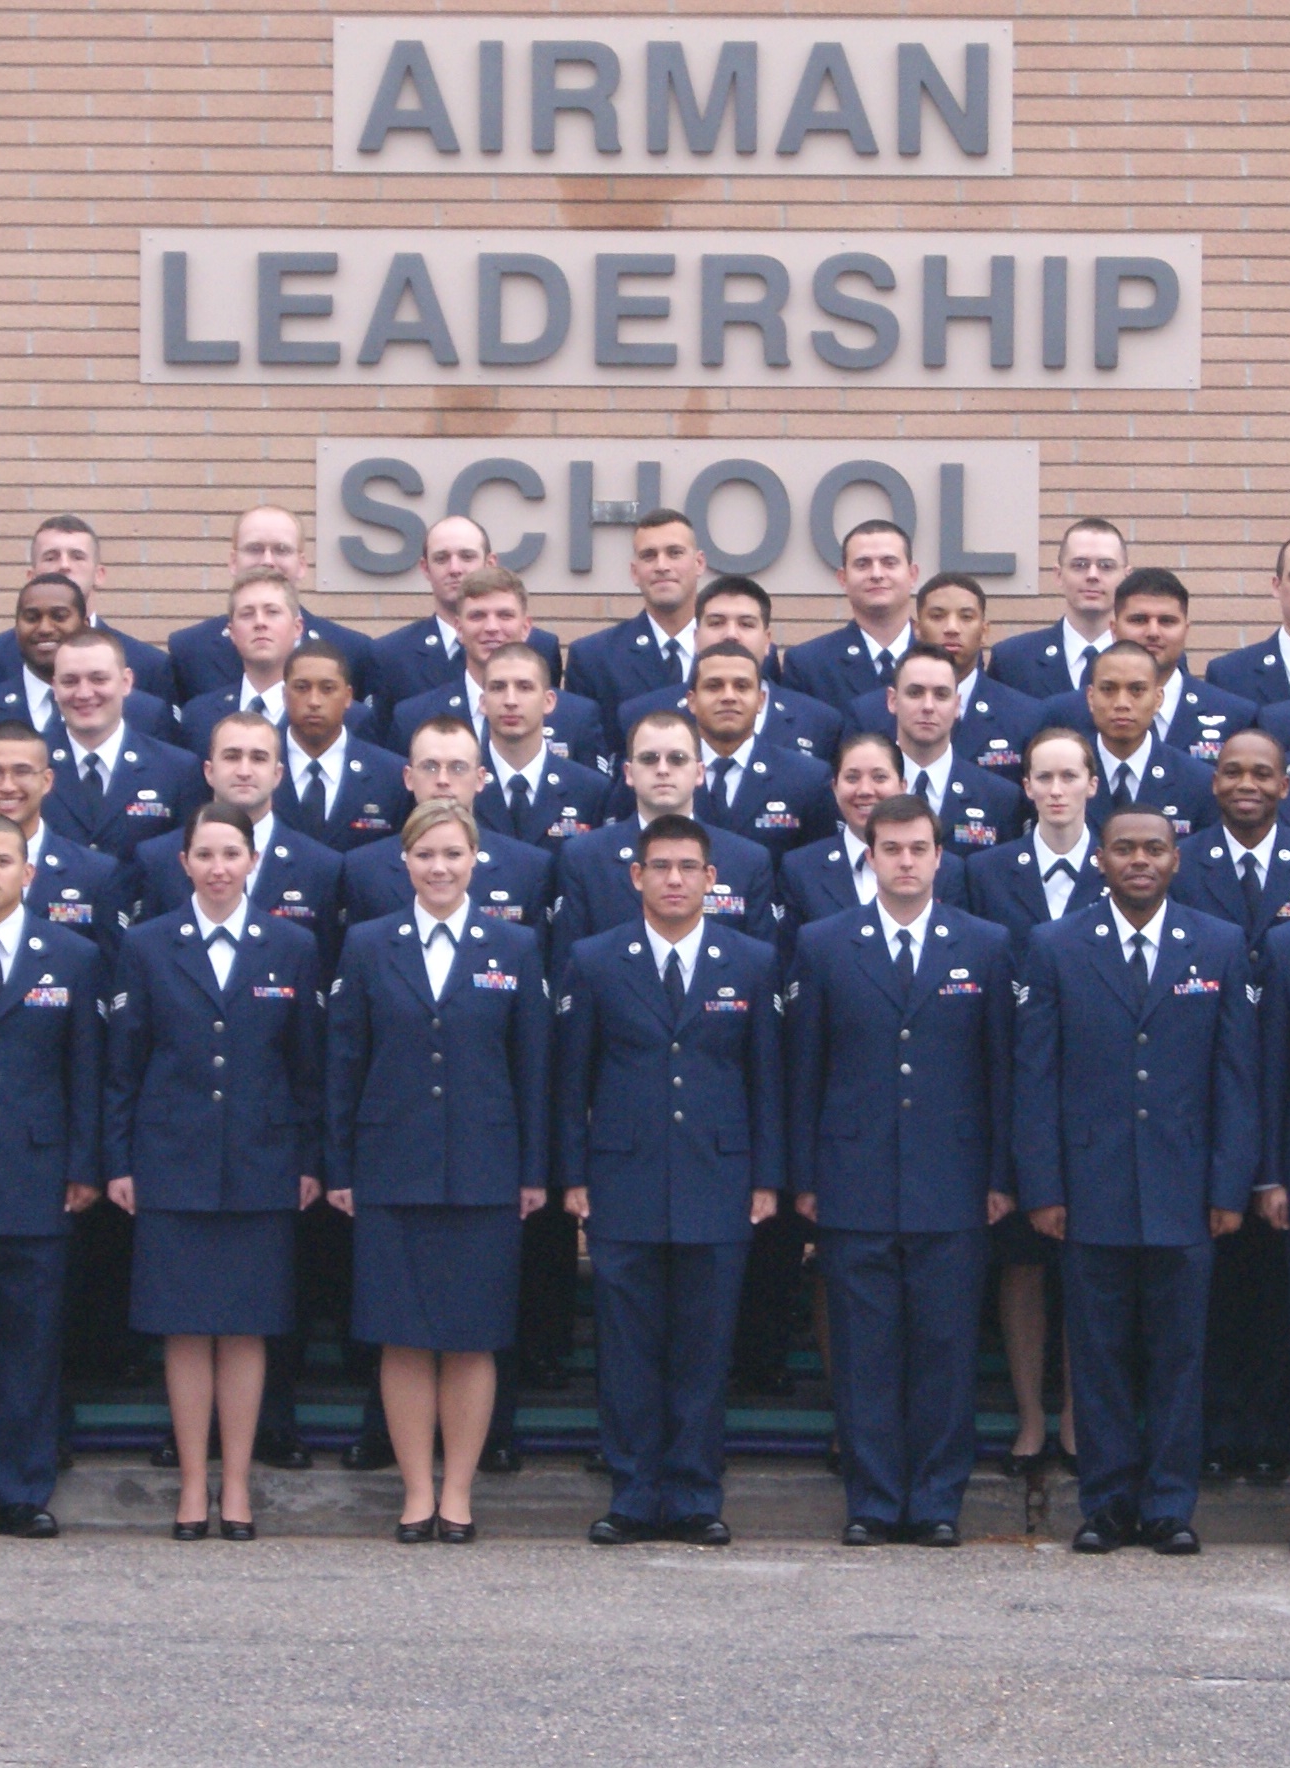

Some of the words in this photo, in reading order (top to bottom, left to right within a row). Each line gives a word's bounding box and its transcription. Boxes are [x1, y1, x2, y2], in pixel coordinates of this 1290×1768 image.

[356, 40, 990, 157] AIRMAN
[162, 251, 1181, 371] LEADERSHIP
[338, 457, 1017, 577] SCHOOL
